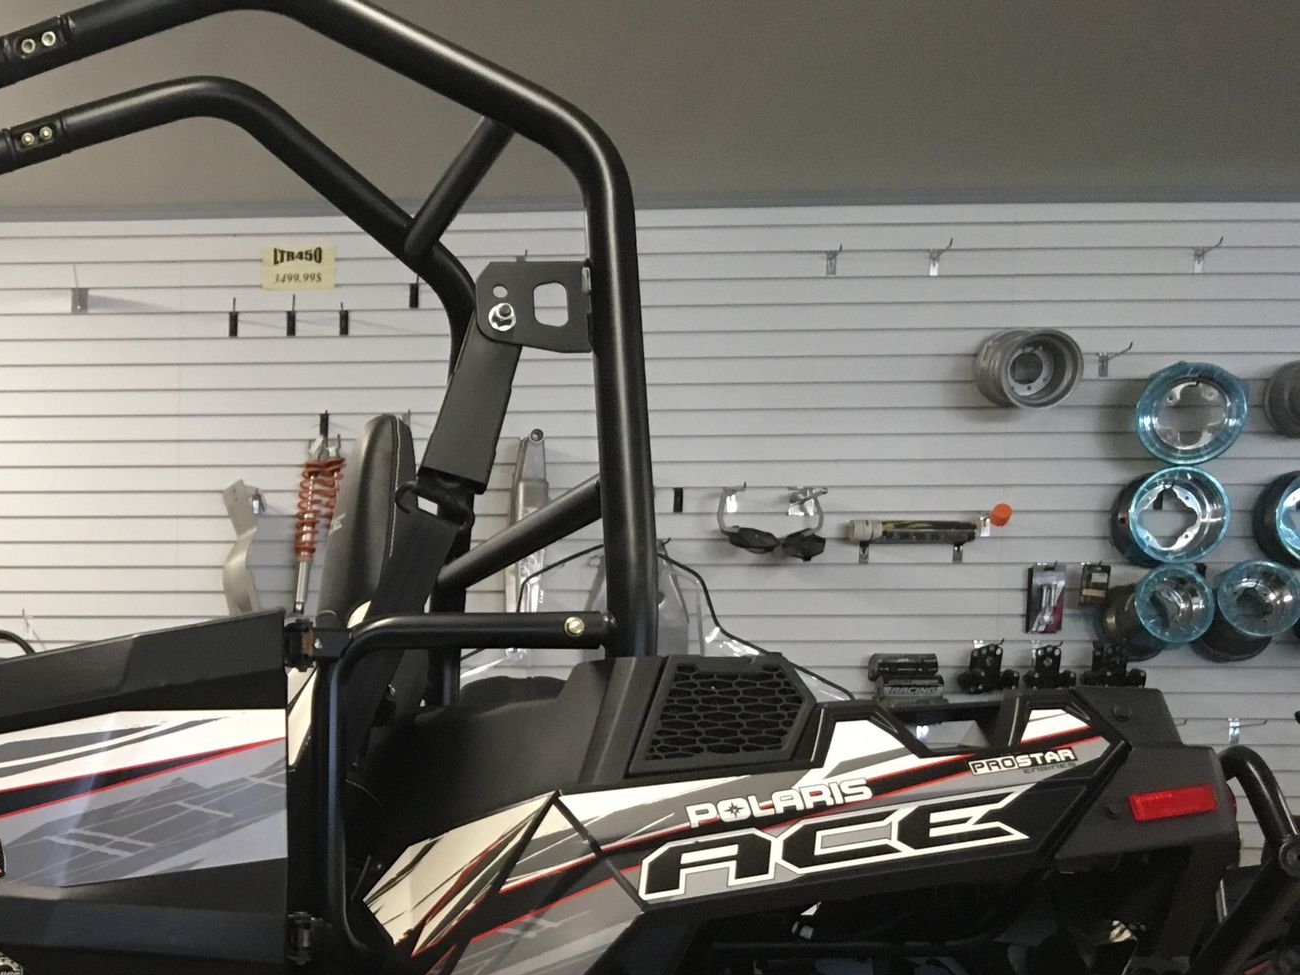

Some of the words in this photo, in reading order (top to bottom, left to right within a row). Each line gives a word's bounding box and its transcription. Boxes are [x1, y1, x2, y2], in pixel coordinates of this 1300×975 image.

[273, 246, 322, 265] LTR450
[970, 748, 1076, 774] PROSTAR
[685, 778, 873, 828] POLARIS
[638, 784, 1037, 901] ACE
